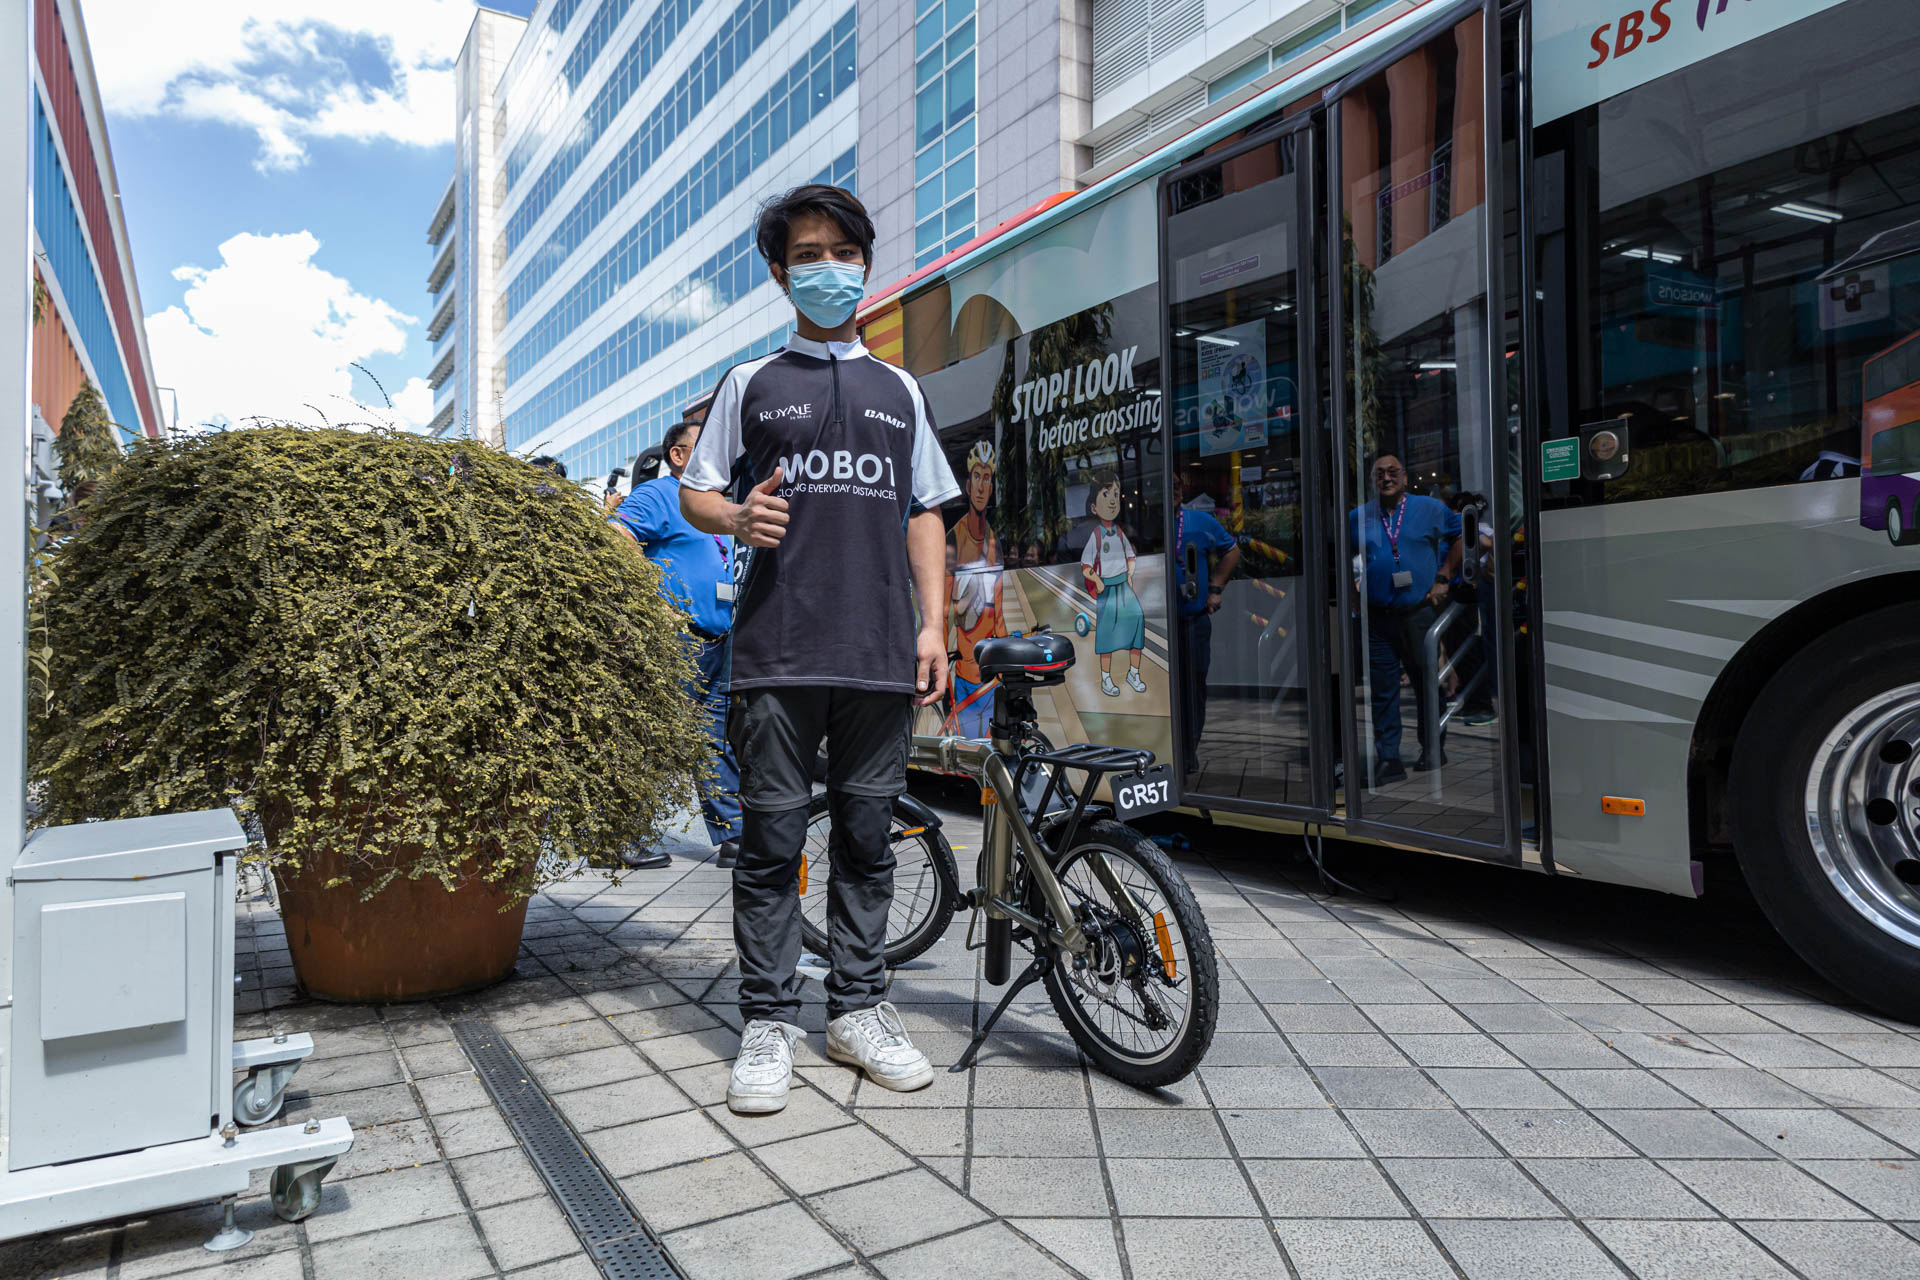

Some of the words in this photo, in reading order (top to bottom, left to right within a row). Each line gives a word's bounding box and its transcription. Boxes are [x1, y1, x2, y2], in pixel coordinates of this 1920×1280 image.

[1587, 0, 1672, 70] SBS
[1011, 368, 1071, 424] STOP!
[1073, 345, 1138, 405] LOOK
[759, 403, 813, 422] ROYALE
[864, 409, 906, 429] CAMP
[1038, 414, 1088, 452] before
[1091, 392, 1162, 439] crossing
[808, 483, 851, 494] EVERYDAY
[852, 485, 897, 501] DISTANCES
[1118, 780, 1169, 810] CR57
